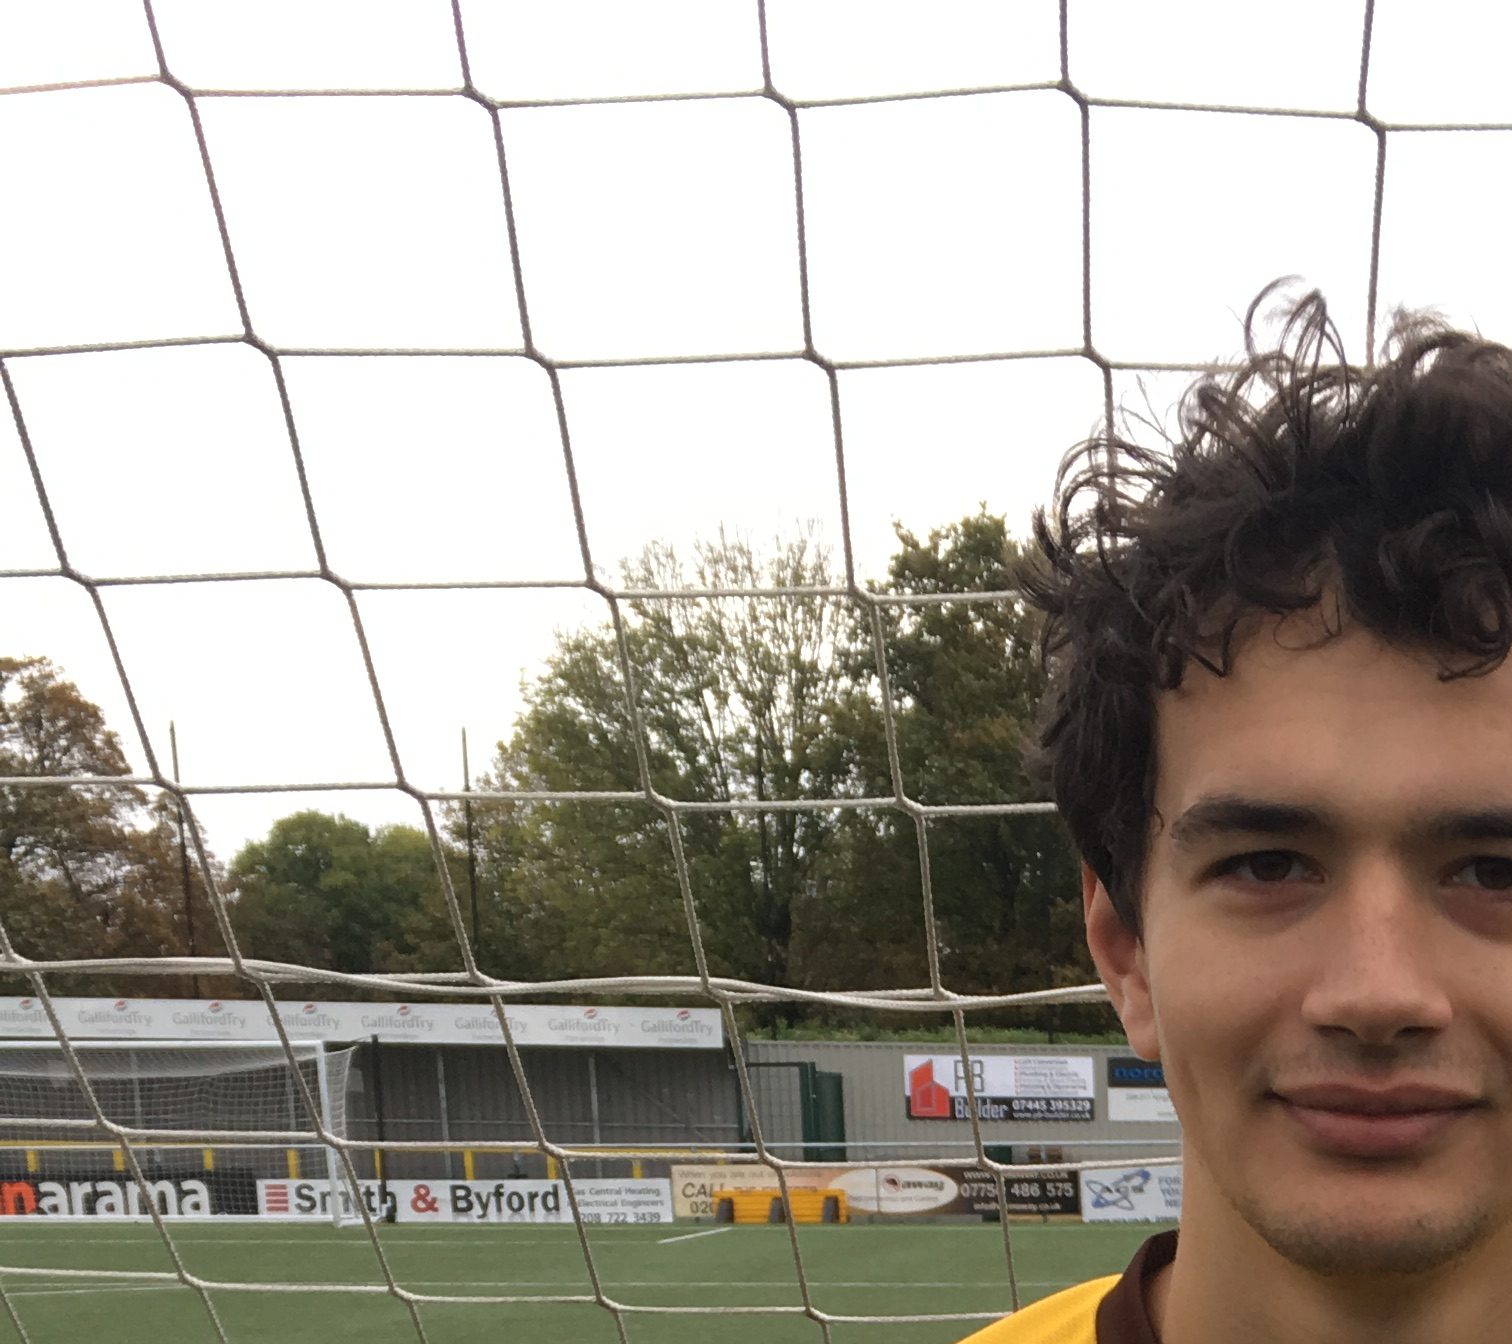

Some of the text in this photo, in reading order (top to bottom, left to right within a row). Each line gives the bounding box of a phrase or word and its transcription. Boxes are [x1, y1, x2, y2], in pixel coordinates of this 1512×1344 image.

[172, 1012, 246, 1030] GallifordTry
[360, 1015, 435, 1032] GallifordTry
[547, 1017, 621, 1034] GallifordTry
[640, 1019, 714, 1036] GallifordTry
[954, 1097, 1008, 1119] Bulder
[589, 1186, 622, 1196] Central
[625, 1187, 661, 1197] Heating
[959, 1182, 1074, 1198] 0775 486 575
[294, 1182, 561, 1219] Smth & Byford
[578, 1199, 664, 1210] Electrical Engineers
[576, 1212, 602, 1223] 208
[607, 1212, 628, 1223] 722
